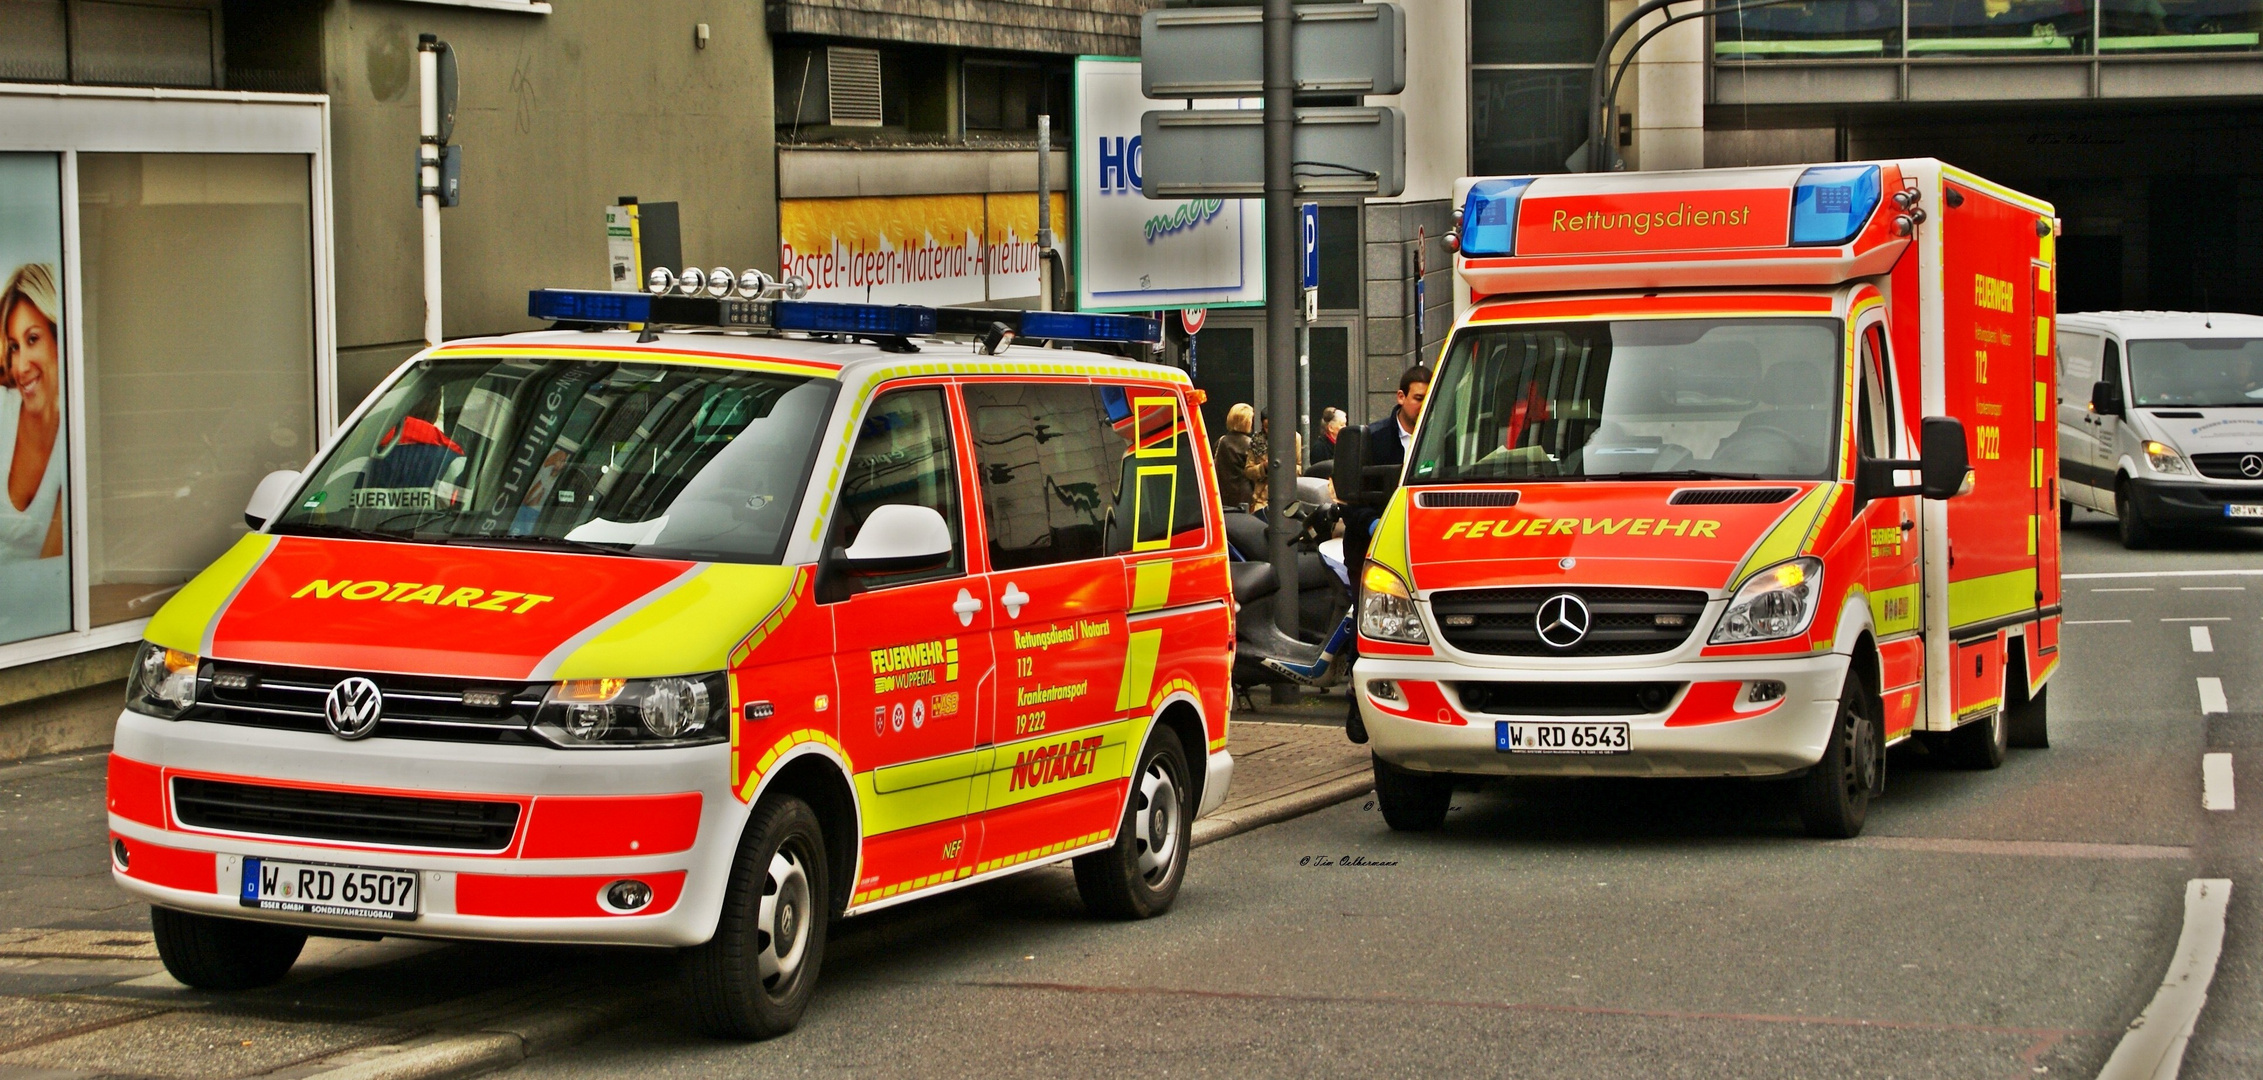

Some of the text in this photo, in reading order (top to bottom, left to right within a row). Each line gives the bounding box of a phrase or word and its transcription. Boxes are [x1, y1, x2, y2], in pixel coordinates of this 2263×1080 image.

[1551, 202, 1750, 236] Rettungsdienst
[781, 229, 1042, 292] Bastel-Ideen-Material-Anleitun
[1306, 214, 1315, 278] P
[1975, 273, 2014, 314] FEUERWEHR
[1975, 350, 1988, 384] 112
[1976, 425, 2000, 460] 19 222
[1442, 518, 1721, 540] FEUERWEHR
[290, 579, 555, 615] NOTARZT
[1013, 623, 1075, 651] Rettungsdienst
[1079, 619, 1110, 639] Notarzt
[870, 640, 945, 675] FEUERWEHR
[1017, 656, 1033, 678] 112
[895, 669, 936, 689] WUPPERTAL
[1017, 679, 1088, 707] Krankentransport
[1016, 710, 1046, 735] 19 222
[1510, 726, 1523, 746] W
[1538, 726, 1566, 747] RD
[1571, 726, 1625, 747] 6543
[1009, 735, 1104, 792] NOTARZT
[942, 839, 962, 860] NEF
[248, 866, 414, 907] D W RD 6507
[260, 901, 394, 920] ESSER GMBH SONDERFAHRZEUGBAU
